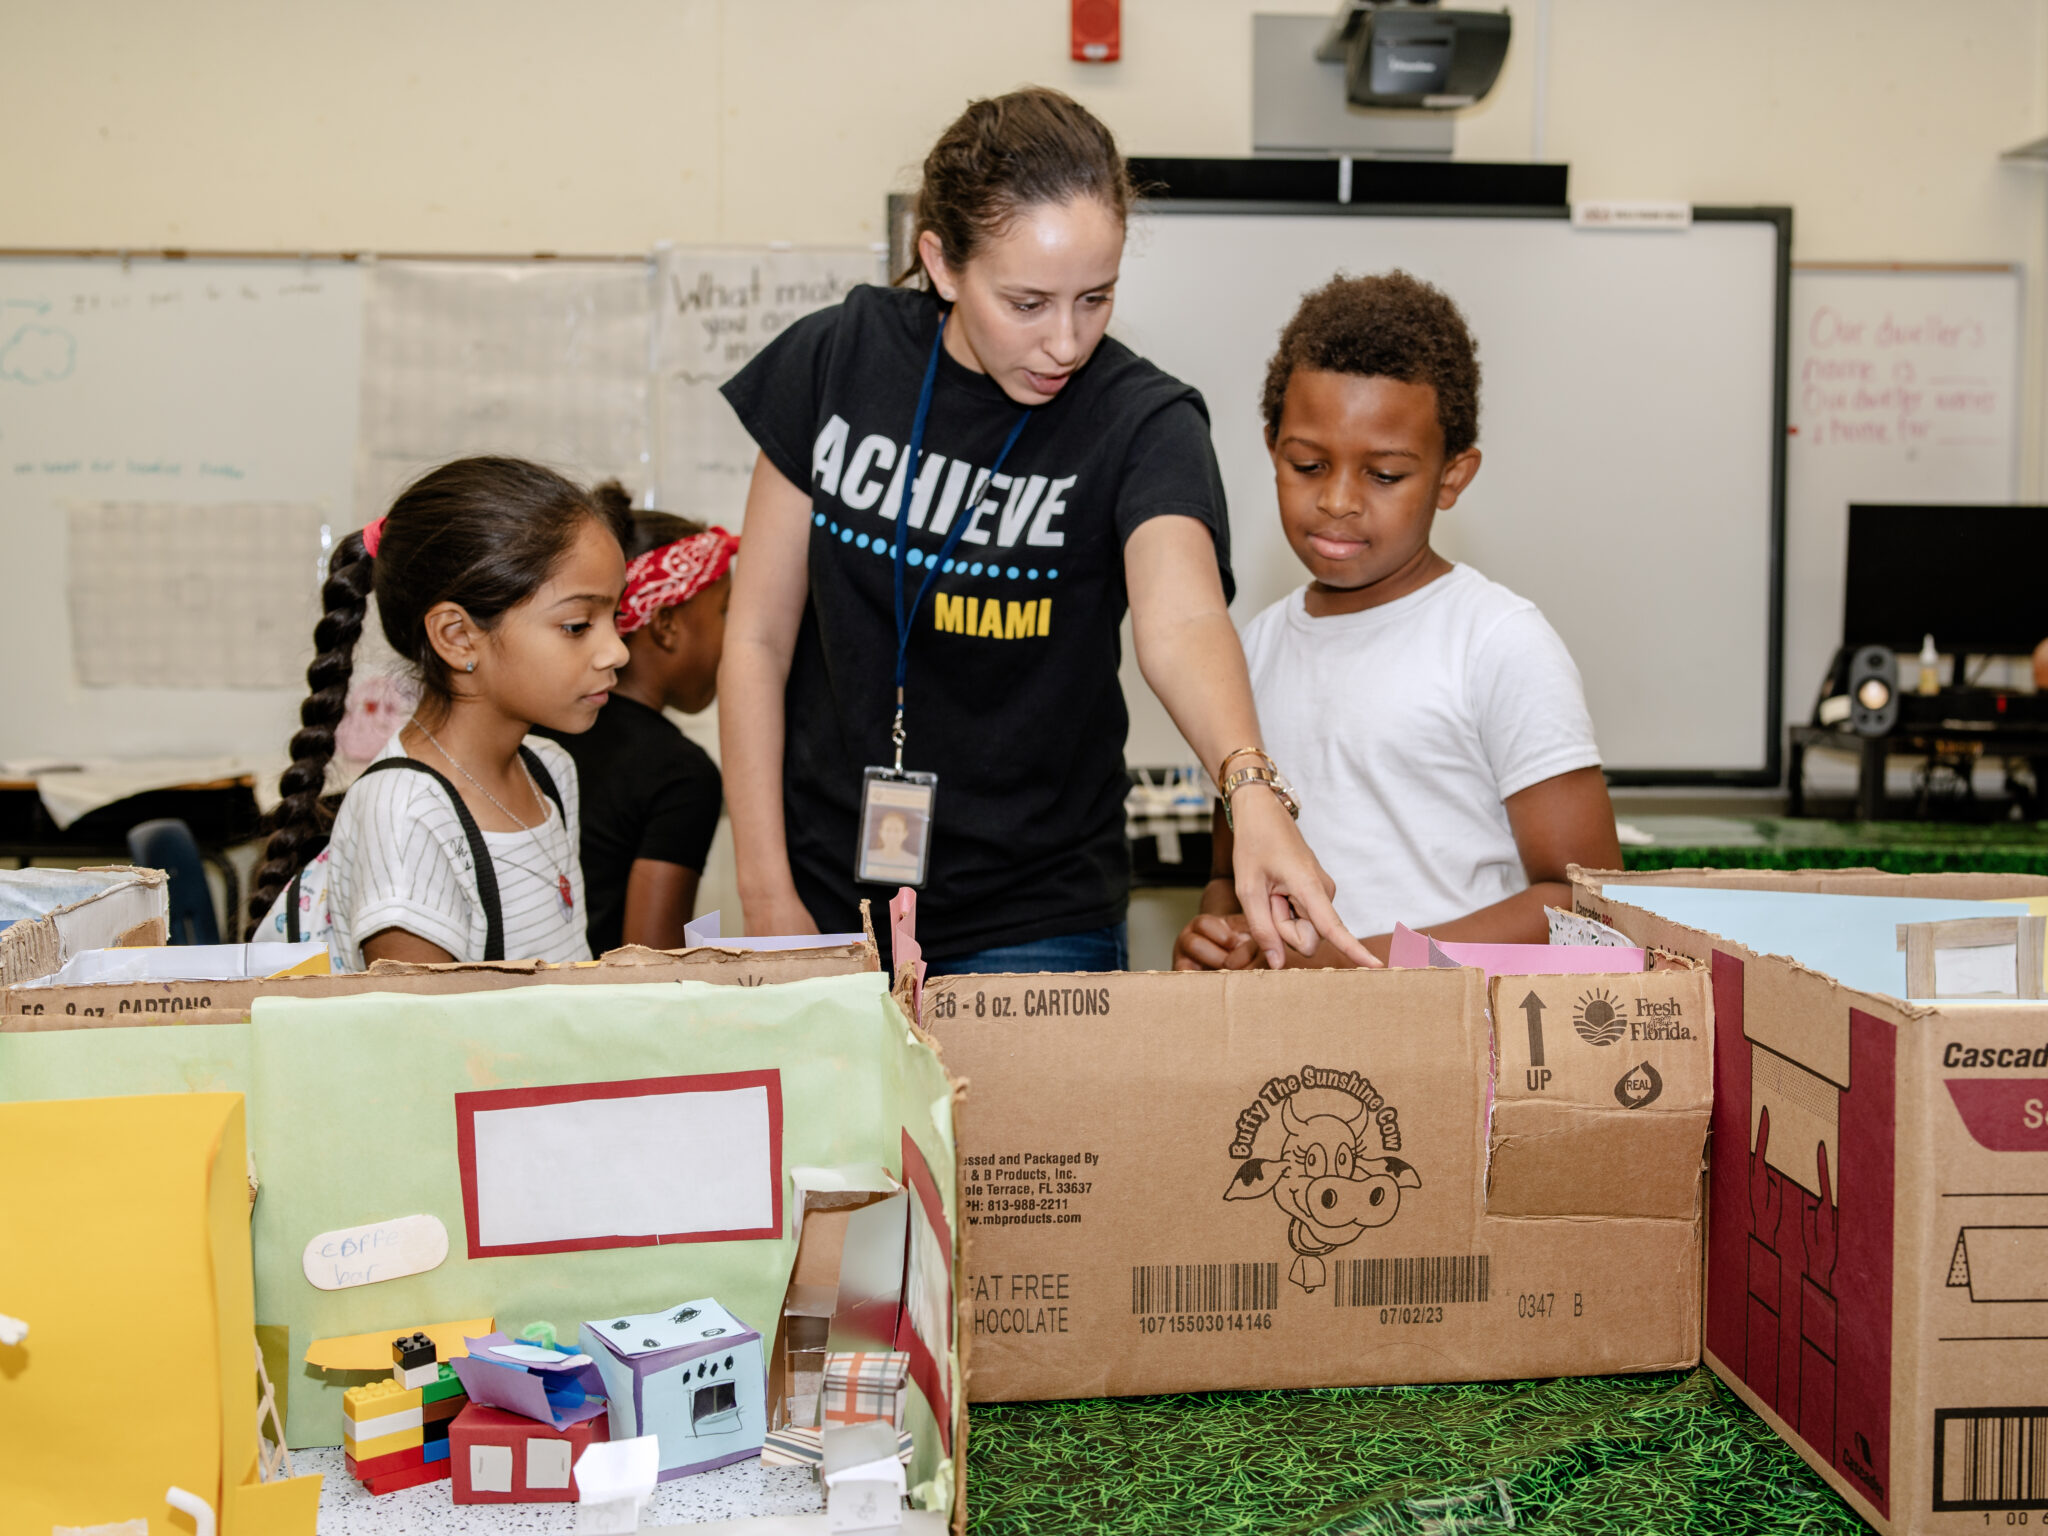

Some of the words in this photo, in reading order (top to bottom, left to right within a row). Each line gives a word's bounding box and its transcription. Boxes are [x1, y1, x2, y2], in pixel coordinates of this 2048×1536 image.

[670, 264, 760, 314] What
[812, 414, 1077, 547] ACHIEVE
[934, 592, 1052, 639] MIAMI
[935, 992, 956, 1018] 56
[975, 991, 986, 1017] 8
[992, 996, 1017, 1017] oz.
[1024, 988, 1110, 1017] CARTONS
[1634, 997, 1682, 1017] Fresh
[1526, 1069, 1552, 1091] UP
[1626, 1080, 1650, 1091] REAL
[1229, 1100, 1270, 1159] Buffy
[1259, 1075, 1300, 1106] The
[1301, 1065, 1385, 1112] Sunshine
[1376, 1106, 1402, 1151] Cow
[2023, 1098, 2048, 1129] S
[999, 1153, 1021, 1166] and
[1024, 1152, 1081, 1166] Packaged
[1085, 1152, 1099, 1166] By
[971, 1169, 980, 1181] &
[984, 1169, 992, 1181] B
[996, 1168, 1051, 1181] Products,
[1055, 1168, 1077, 1180] Inc.
[987, 1183, 1035, 1196] Terrace,
[1039, 1183, 1053, 1194] FL
[1056, 1182, 1093, 1194] 33637
[988, 1198, 1068, 1211] 813-988-2211
[1012, 1274, 1070, 1300] FREE
[1380, 1307, 1443, 1324] 07/02/23
[1518, 1293, 1555, 1318] 0347
[1574, 1293, 1583, 1317] B
[974, 1307, 1069, 1335] HOCOLATE
